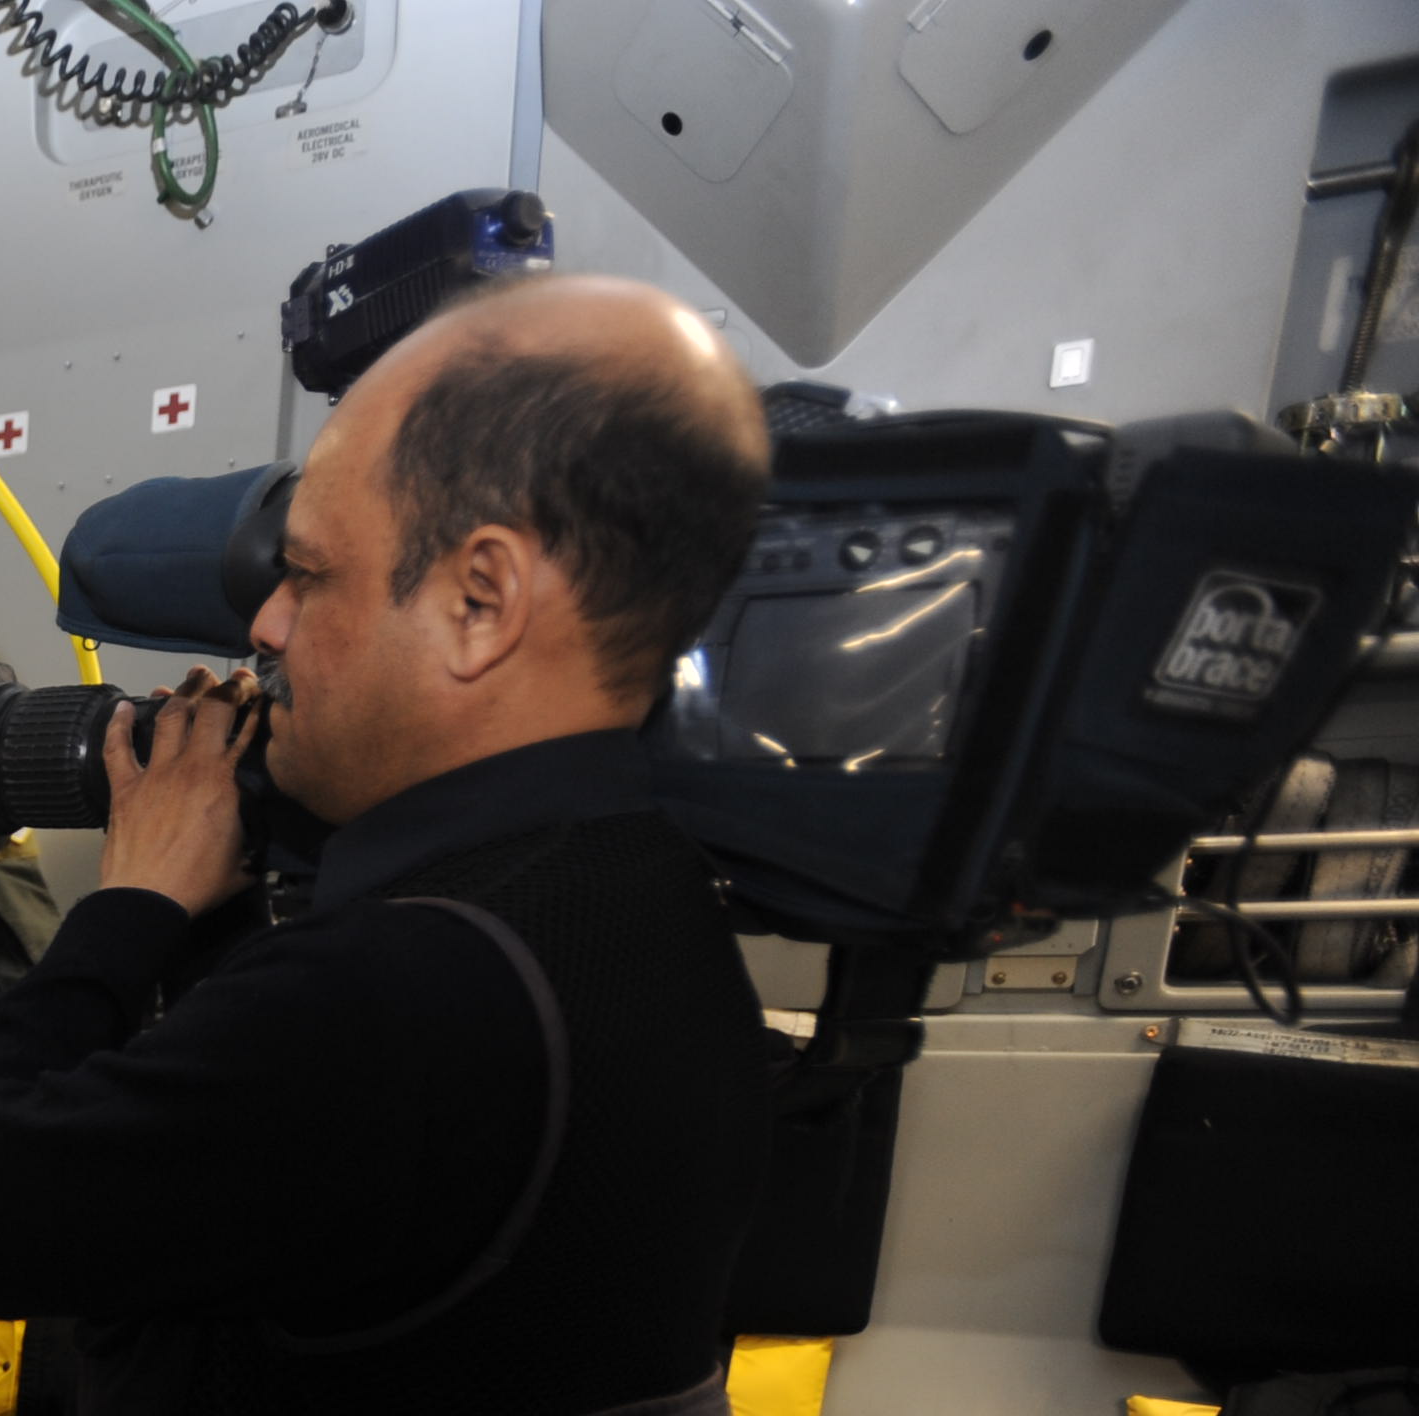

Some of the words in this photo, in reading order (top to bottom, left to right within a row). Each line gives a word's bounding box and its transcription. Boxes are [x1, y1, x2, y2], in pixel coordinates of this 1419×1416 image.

[296, 119, 361, 141] AEROMEDICAL
[301, 132, 355, 153] ELECTRICAL
[69, 171, 124, 191] THERAPEUTIC
[79, 186, 113, 202] OXYGEN
[1184, 604, 1293, 653] porta
[1166, 643, 1274, 693] brace
